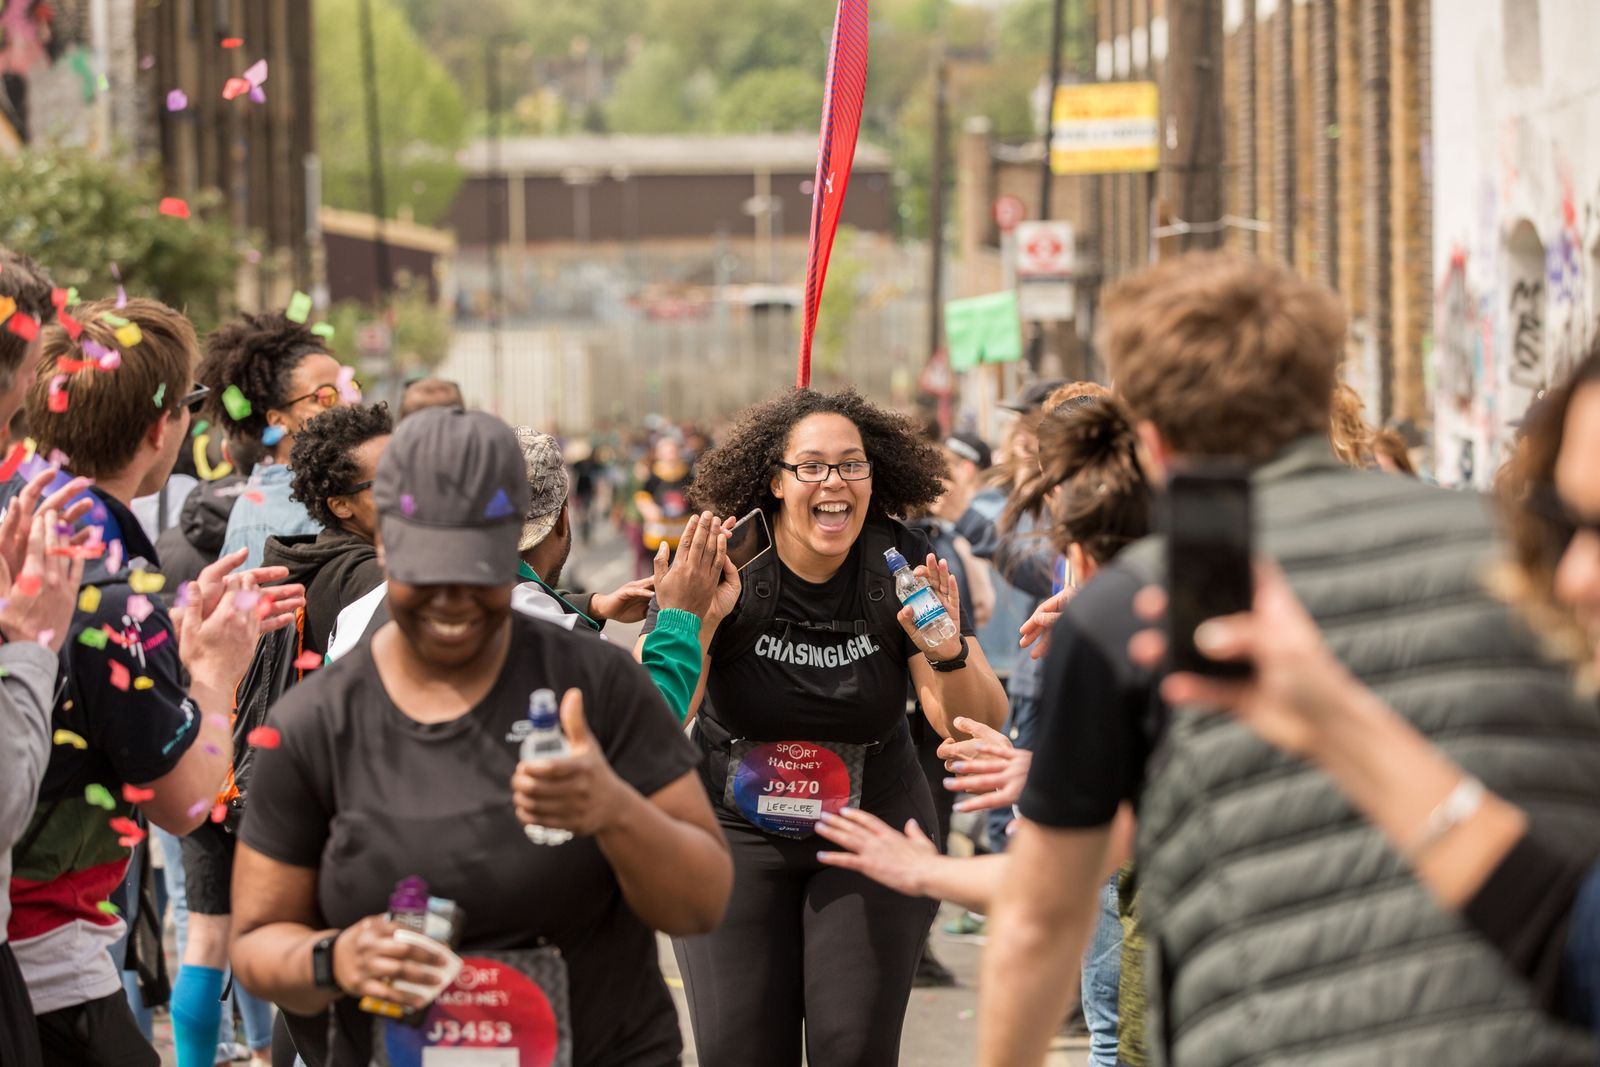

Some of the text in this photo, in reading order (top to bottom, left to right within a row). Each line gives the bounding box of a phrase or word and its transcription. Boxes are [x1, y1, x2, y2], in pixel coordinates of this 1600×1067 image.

[776, 743, 818, 759] SPORT
[767, 757, 823, 771] HACKNEY
[763, 780, 820, 794] J9470
[453, 965, 501, 990] ORT
[426, 1019, 513, 1044] J3453
